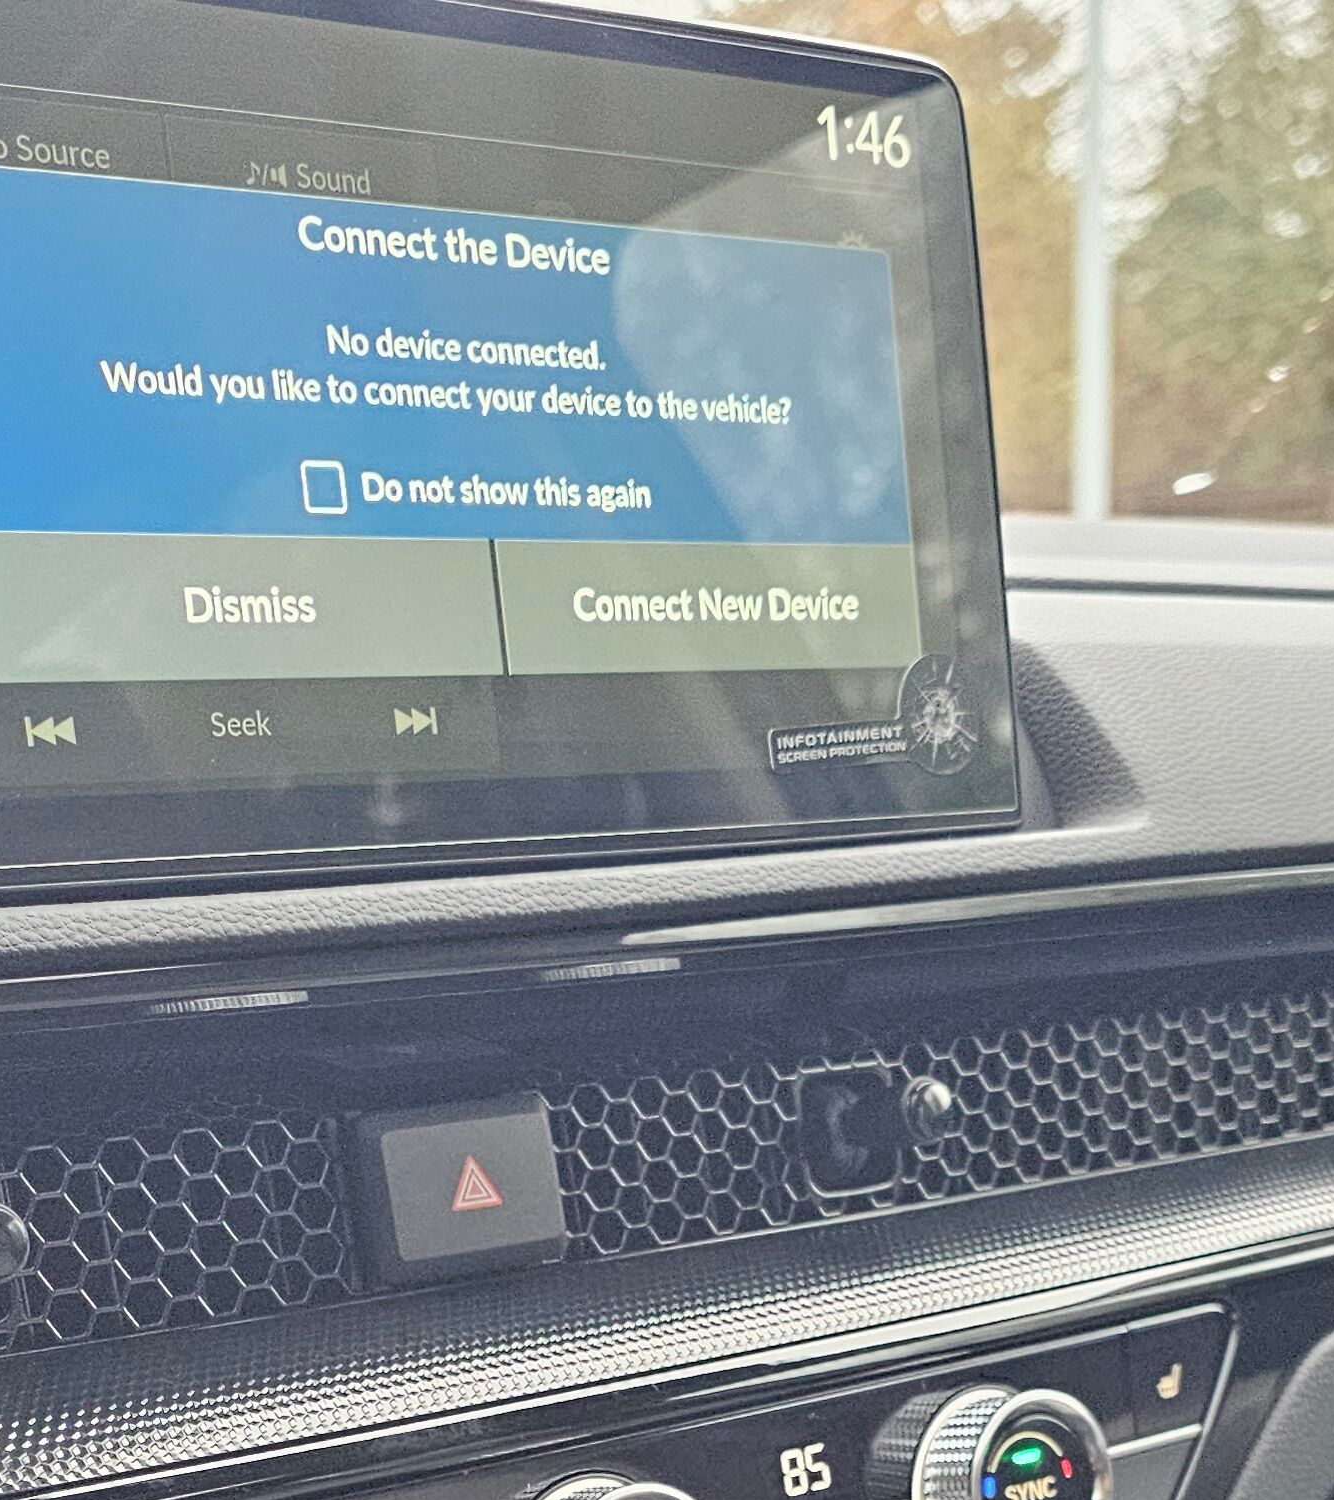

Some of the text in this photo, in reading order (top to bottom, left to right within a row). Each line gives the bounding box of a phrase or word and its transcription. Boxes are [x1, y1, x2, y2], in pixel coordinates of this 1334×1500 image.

[16, 134, 111, 170] Source
[817, 105, 912, 169] 1:46
[296, 163, 371, 196] Sound
[298, 215, 611, 275] Connect the Device
[326, 324, 606, 371] No device connected.
[100, 360, 792, 425] Would you like to connect your device to the vehicle?
[361, 471, 652, 512] Do not show this again
[183, 585, 317, 624] Dismiss
[573, 586, 860, 623] Connect New Device
[210, 709, 273, 738] Seek
[777, 725, 903, 750] INFOTAINMENT
[777, 741, 906, 764] SCREEN PROTECTION
[779, 1442, 832, 1497] 85
